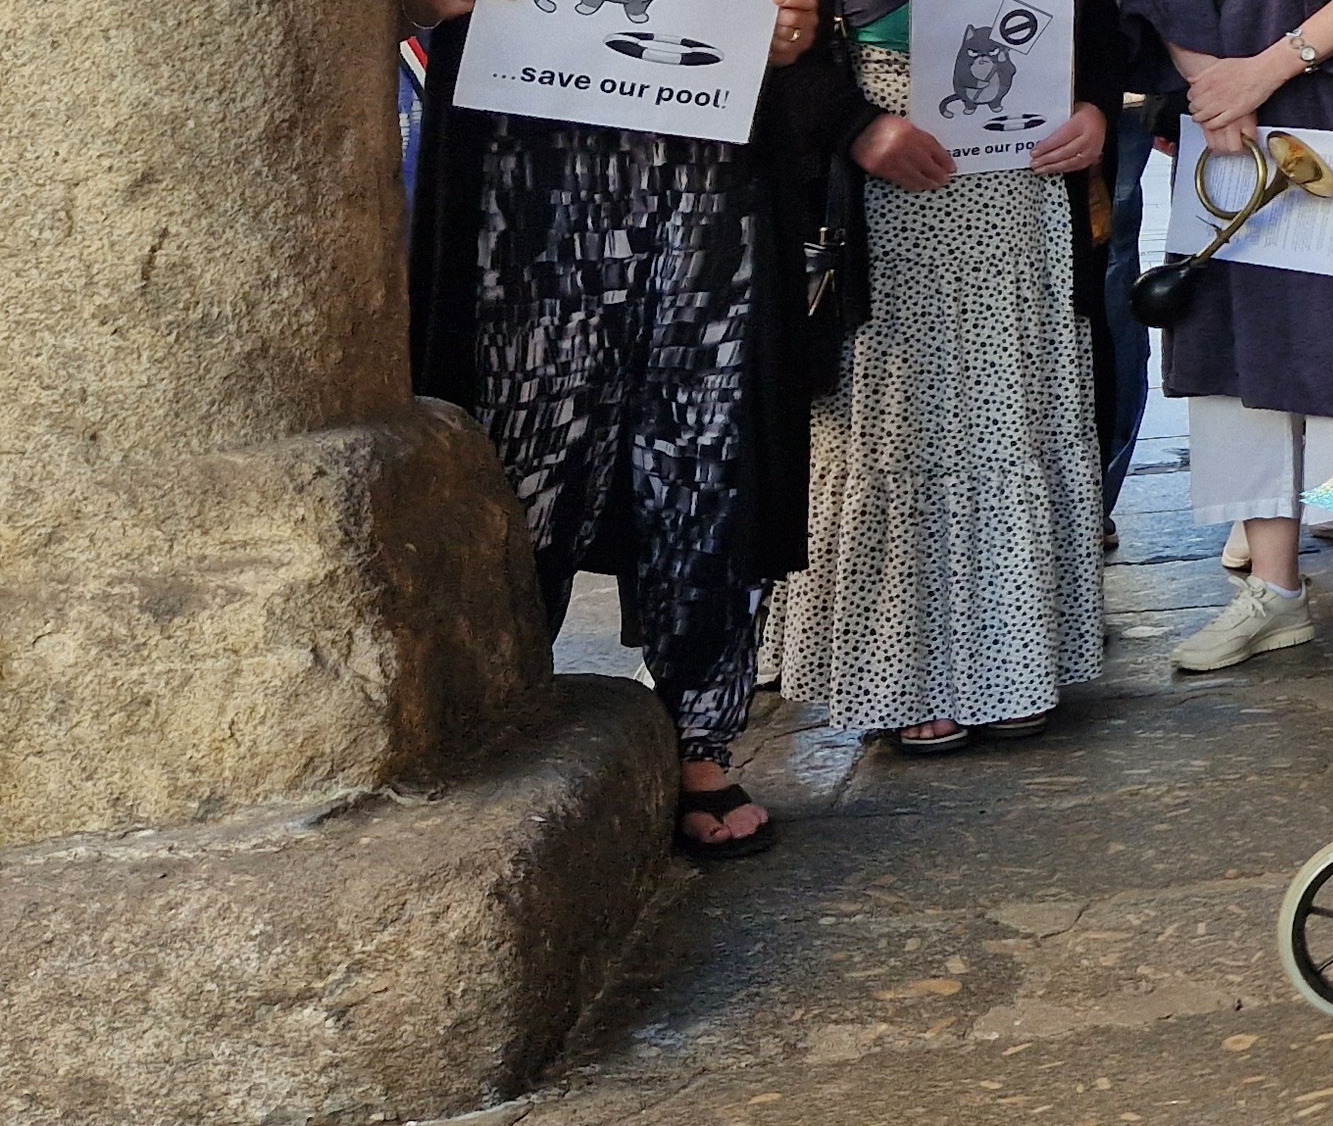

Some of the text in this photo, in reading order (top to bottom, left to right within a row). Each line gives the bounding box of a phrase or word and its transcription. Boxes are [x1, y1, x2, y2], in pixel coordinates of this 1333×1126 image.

[492, 66, 730, 110] ...save our pool!
[984, 143, 1011, 154] our
